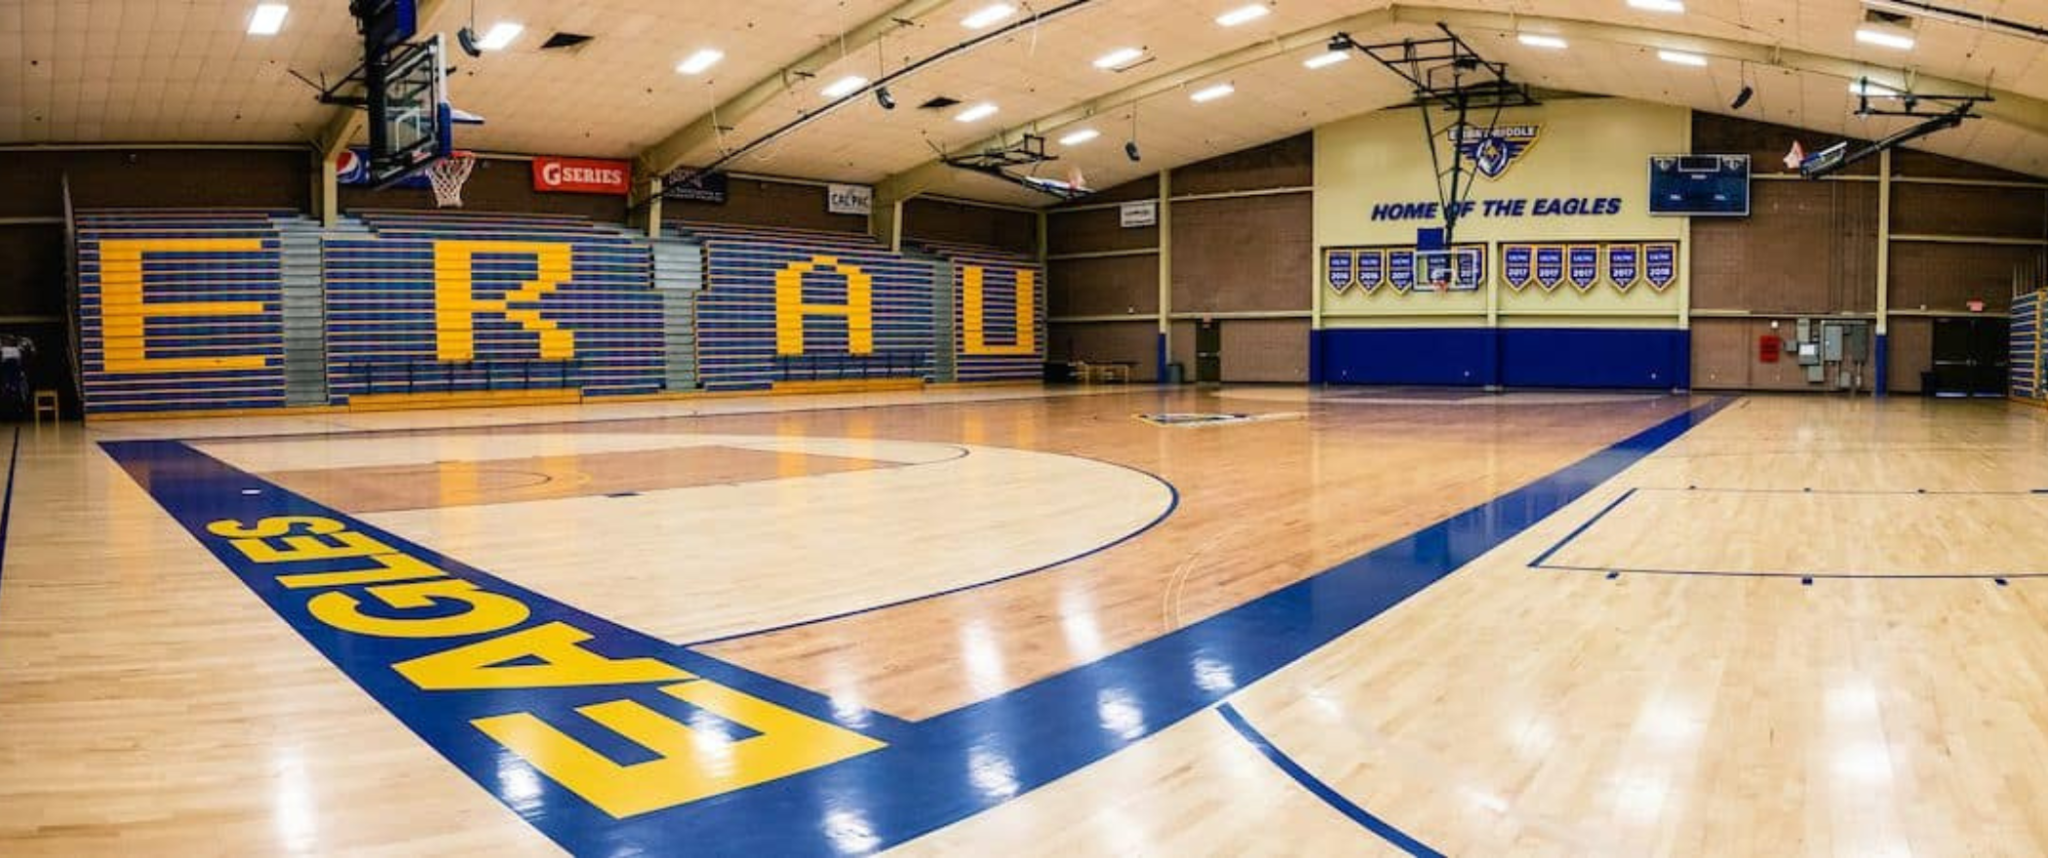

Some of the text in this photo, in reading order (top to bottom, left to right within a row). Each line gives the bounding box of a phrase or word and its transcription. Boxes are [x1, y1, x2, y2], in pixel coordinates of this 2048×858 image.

[1371, 202, 1439, 221] HOME
[1483, 199, 1527, 217] THE
[1532, 197, 1622, 216] EAGLES
[206, 515, 890, 820] EAGLES
